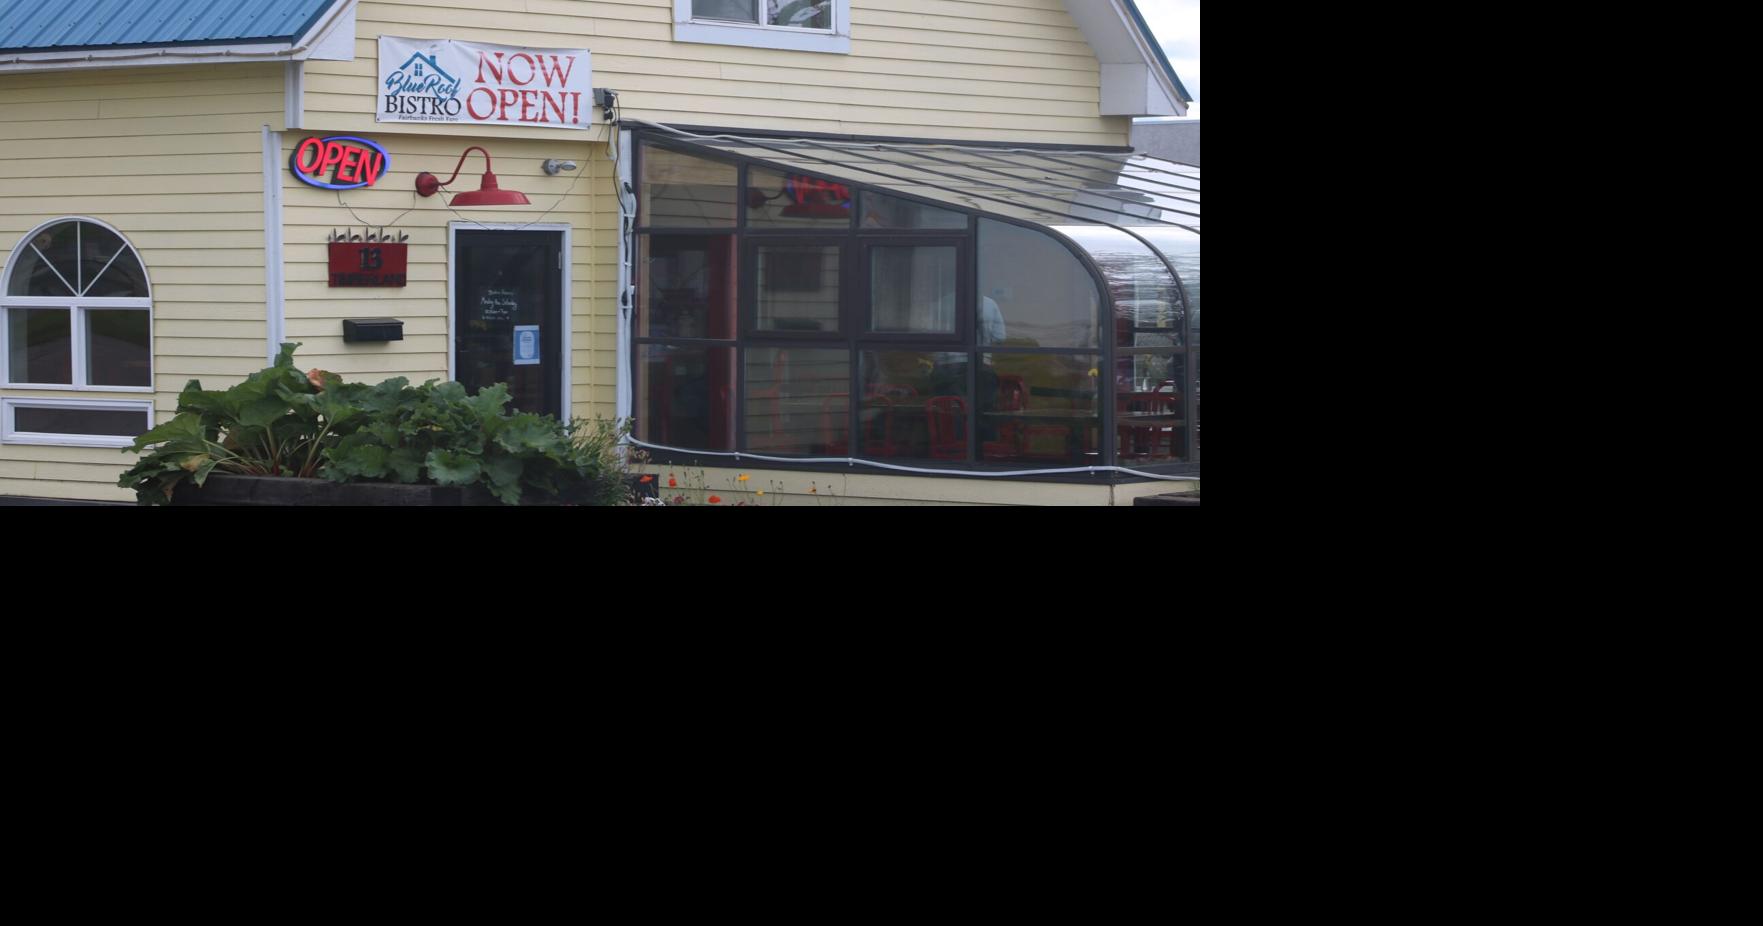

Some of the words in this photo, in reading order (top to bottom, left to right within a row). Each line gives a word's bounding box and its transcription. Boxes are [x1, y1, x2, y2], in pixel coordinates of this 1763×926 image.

[474, 51, 576, 88] NOW
[385, 95, 461, 116] BISTRO
[466, 87, 582, 124] OPEN!
[296, 137, 383, 187] OPEN
[358, 247, 384, 270] 13
